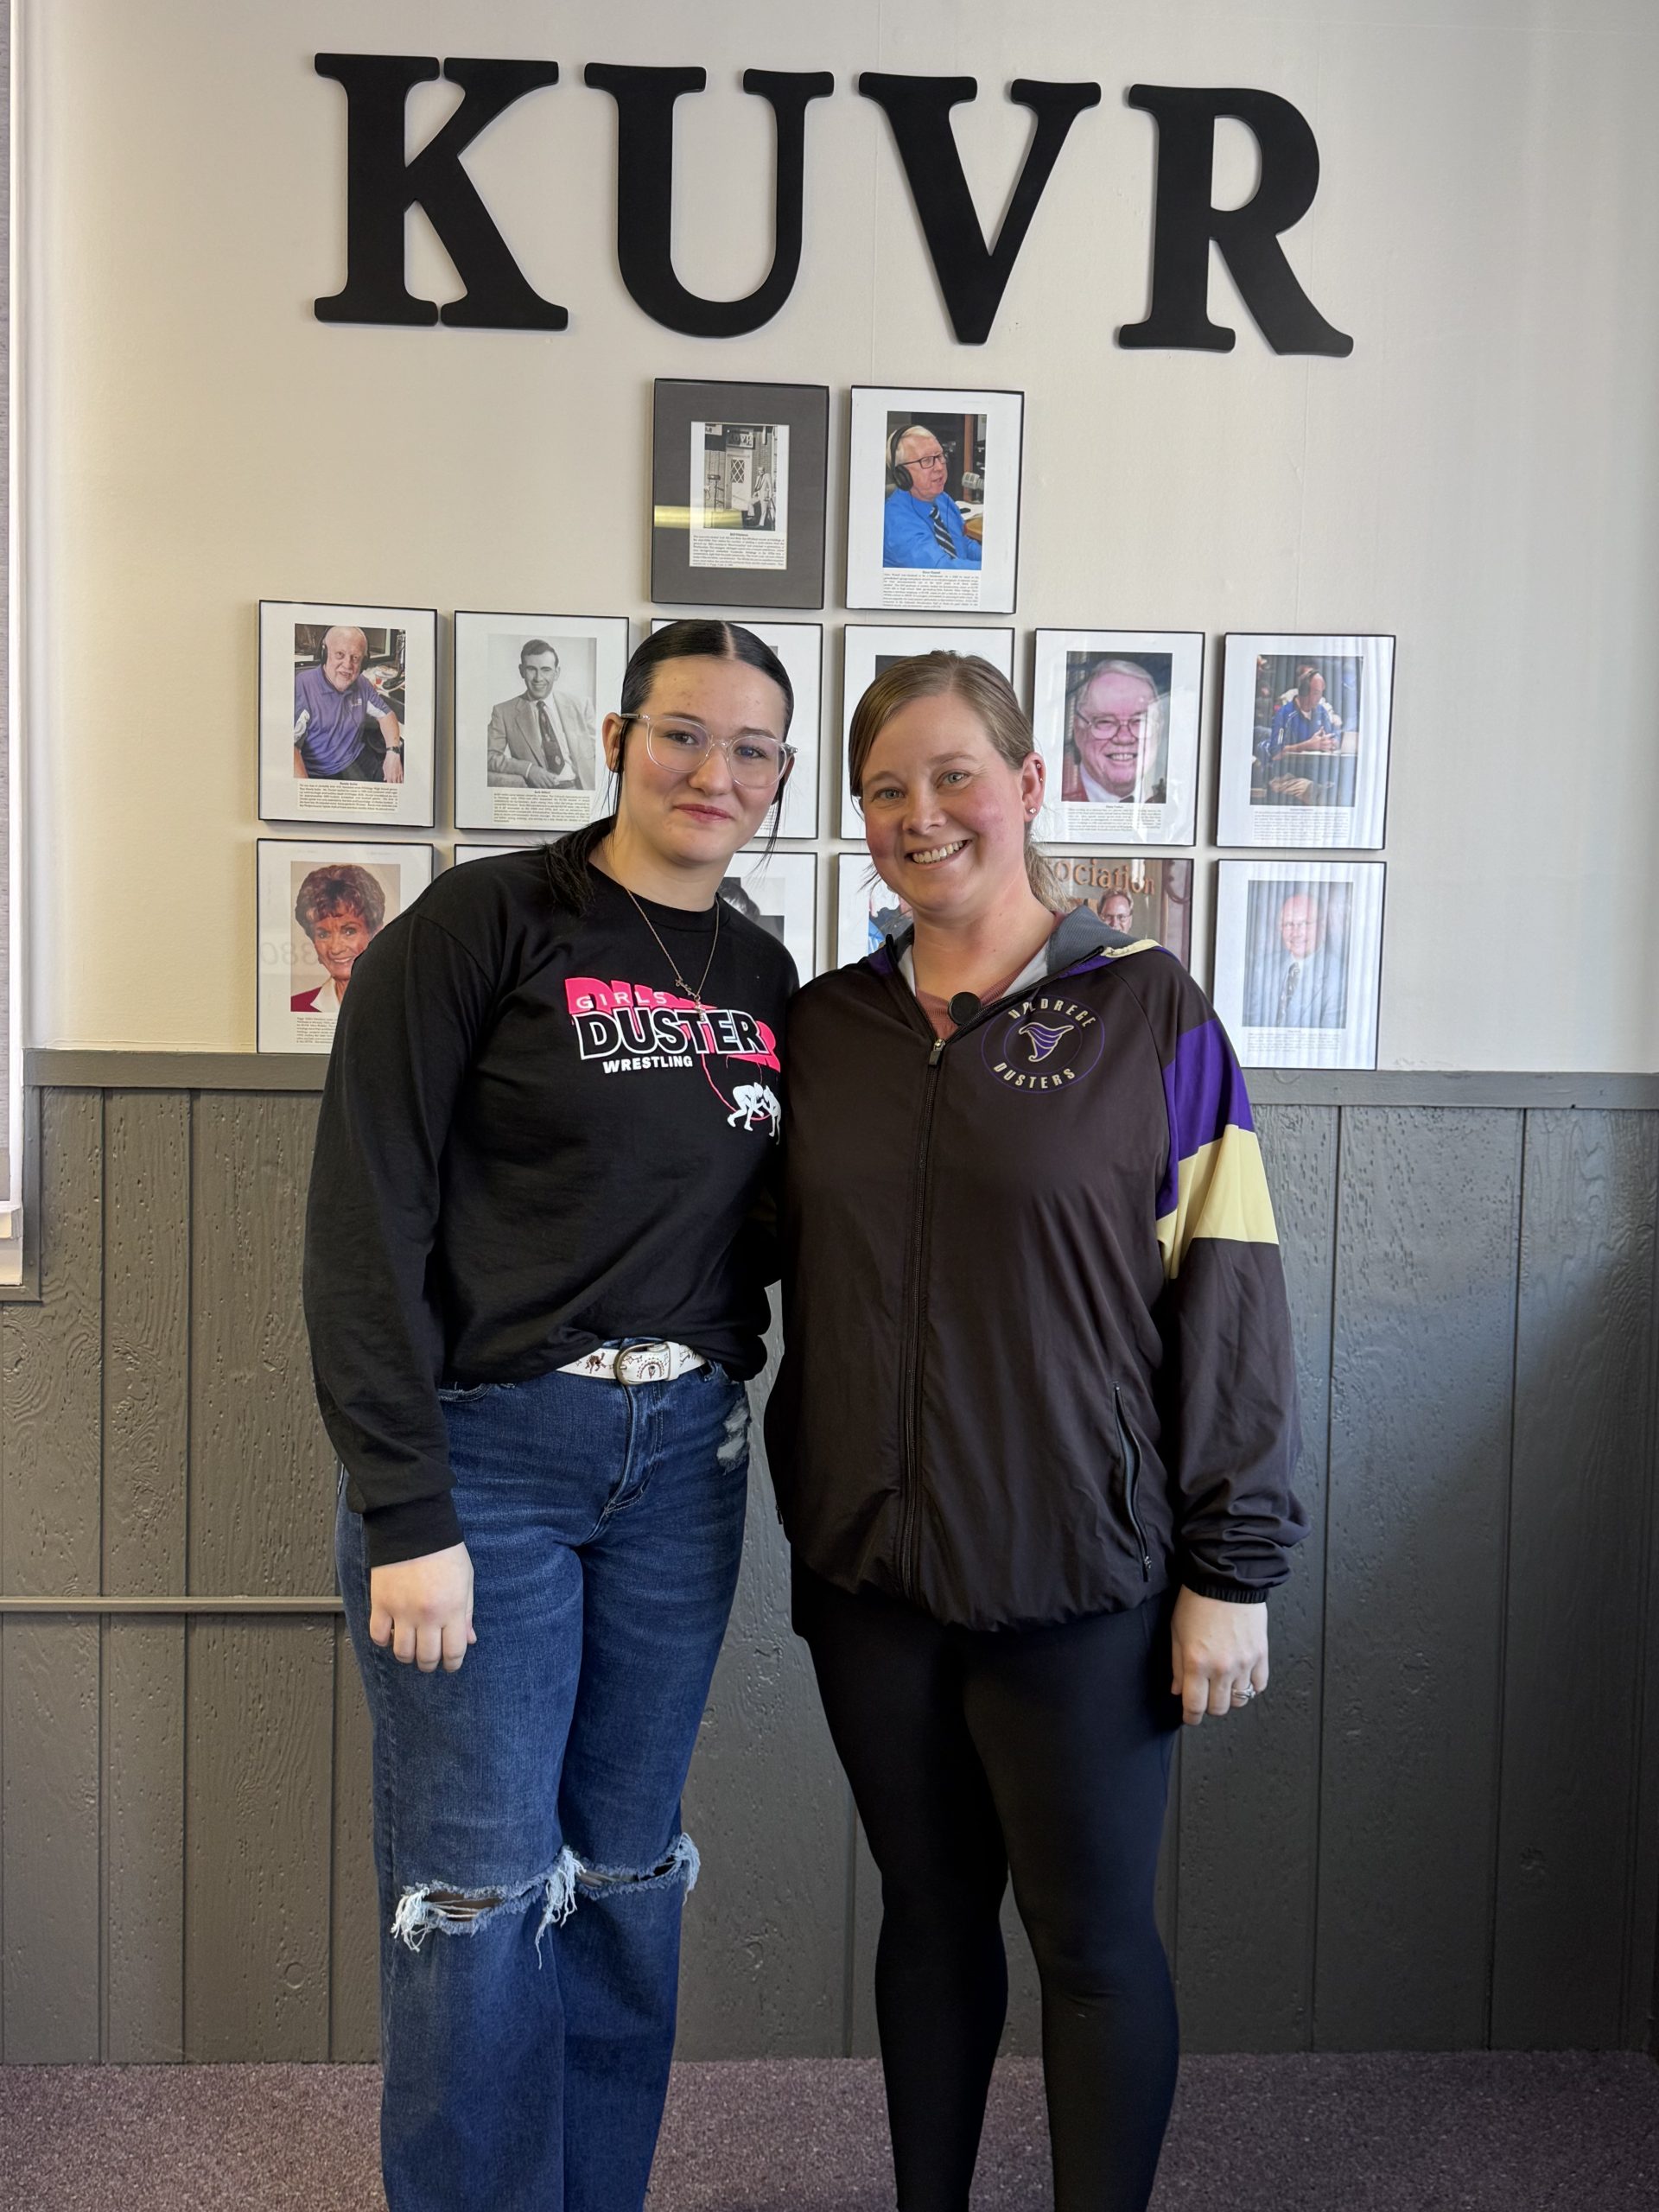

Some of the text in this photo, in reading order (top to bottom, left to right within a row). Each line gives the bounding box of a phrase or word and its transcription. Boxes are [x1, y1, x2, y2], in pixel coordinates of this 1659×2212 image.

[314, 53, 1354, 358] KUVR
[1054, 859, 1155, 895] ociation
[575, 991, 668, 1009] GIRLS
[571, 1006, 769, 1060] DUSTER
[602, 1055, 694, 1074] WRESTLING
[993, 1061, 1076, 1089] DUSTERS
